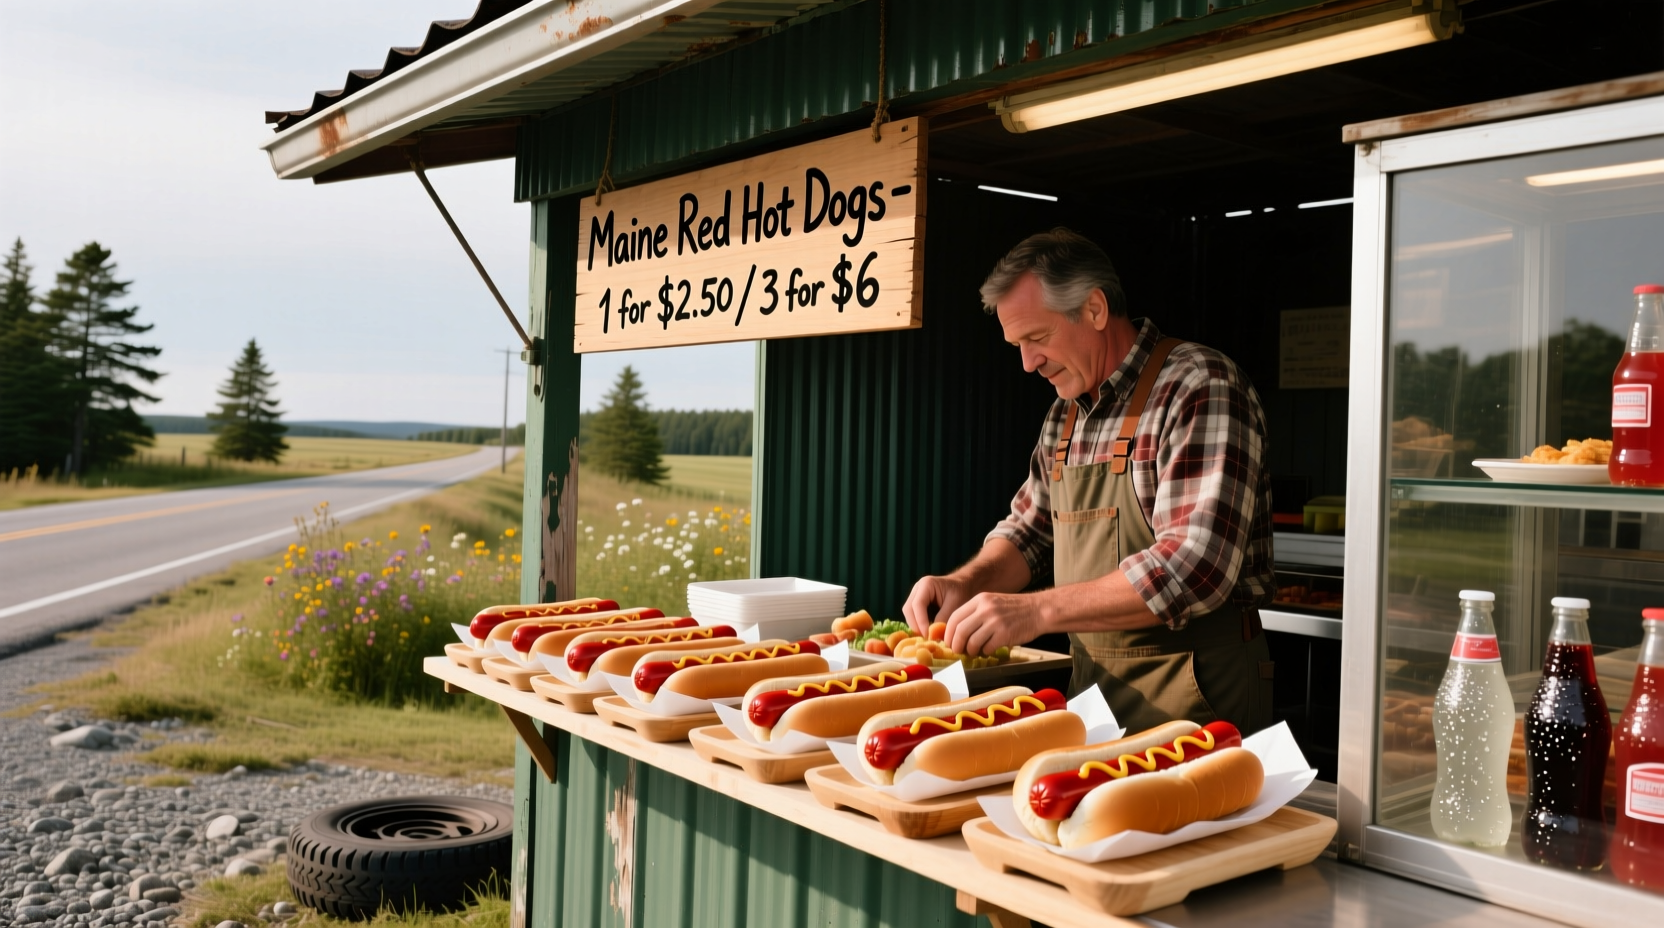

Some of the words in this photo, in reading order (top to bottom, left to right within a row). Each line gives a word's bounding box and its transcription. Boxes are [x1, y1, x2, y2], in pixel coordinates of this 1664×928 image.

[587, 209, 668, 271] Maine
[677, 189, 732, 256] Red
[741, 181, 795, 245] Hot
[598, 287, 611, 334] 1
[617, 288, 652, 330] for
[785, 267, 826, 313] for
[831, 251, 880, 313] $6
